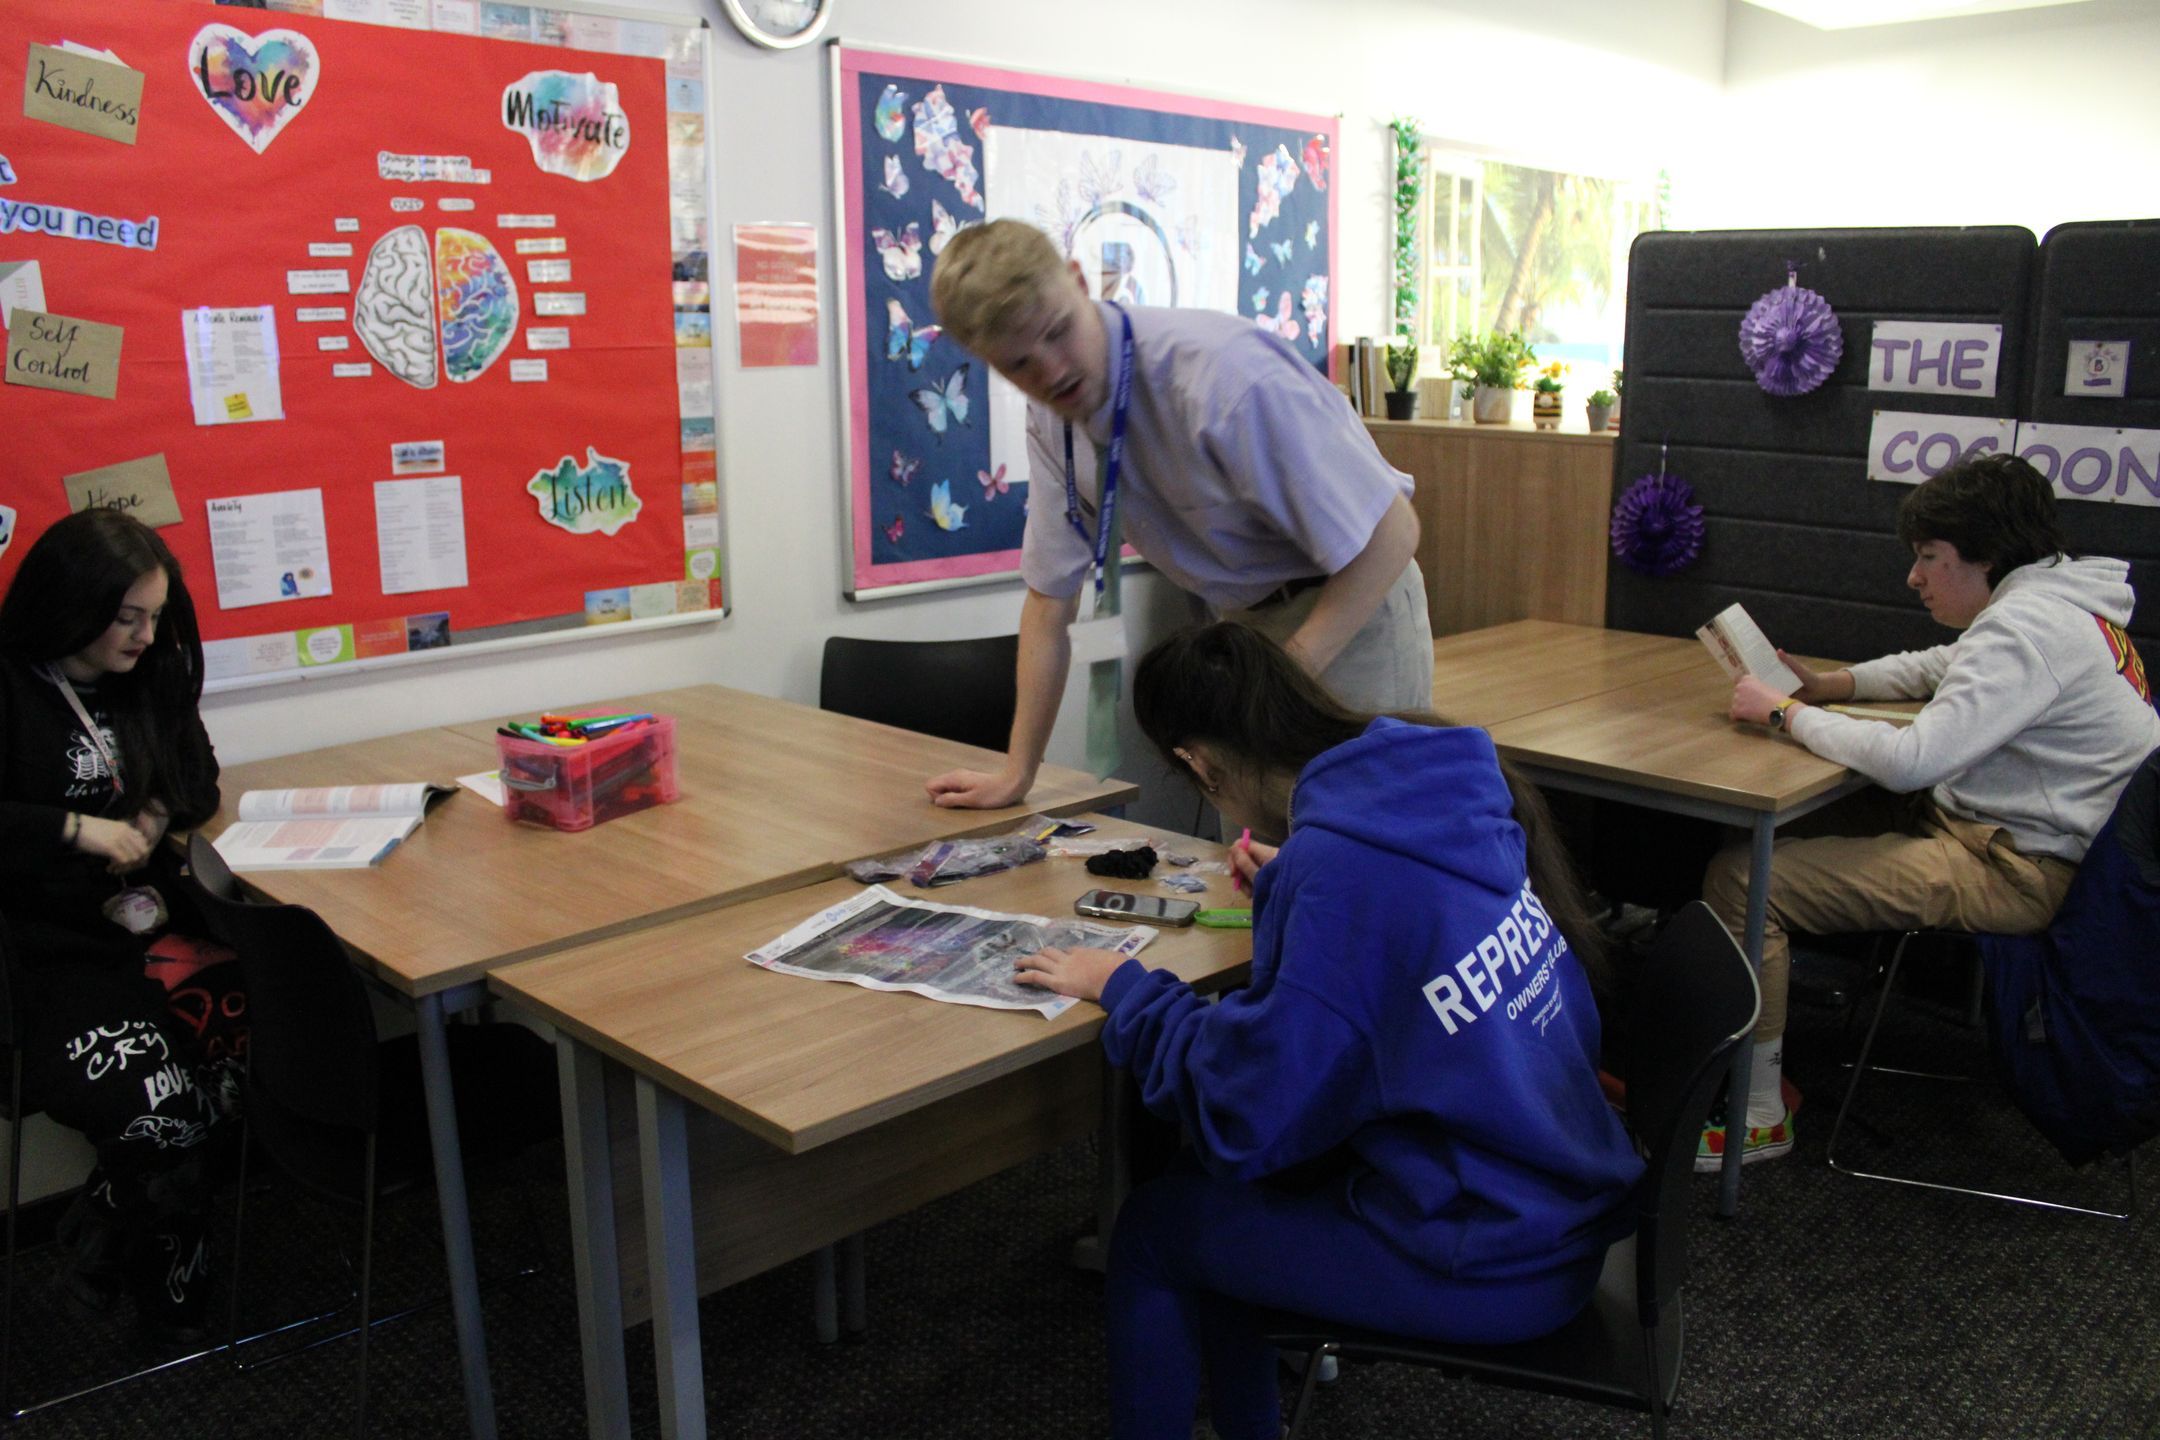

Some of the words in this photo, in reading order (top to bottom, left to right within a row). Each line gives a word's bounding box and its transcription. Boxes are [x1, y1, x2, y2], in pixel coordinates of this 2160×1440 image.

[35, 60, 136, 126] Kindness
[200, 46, 302, 106] Love
[0, 201, 63, 231] you
[76, 215, 155, 247] need
[29, 316, 79, 357] Self
[13, 348, 89, 383] Control
[1872, 339, 1989, 389] THE
[85, 489, 144, 512] Hope
